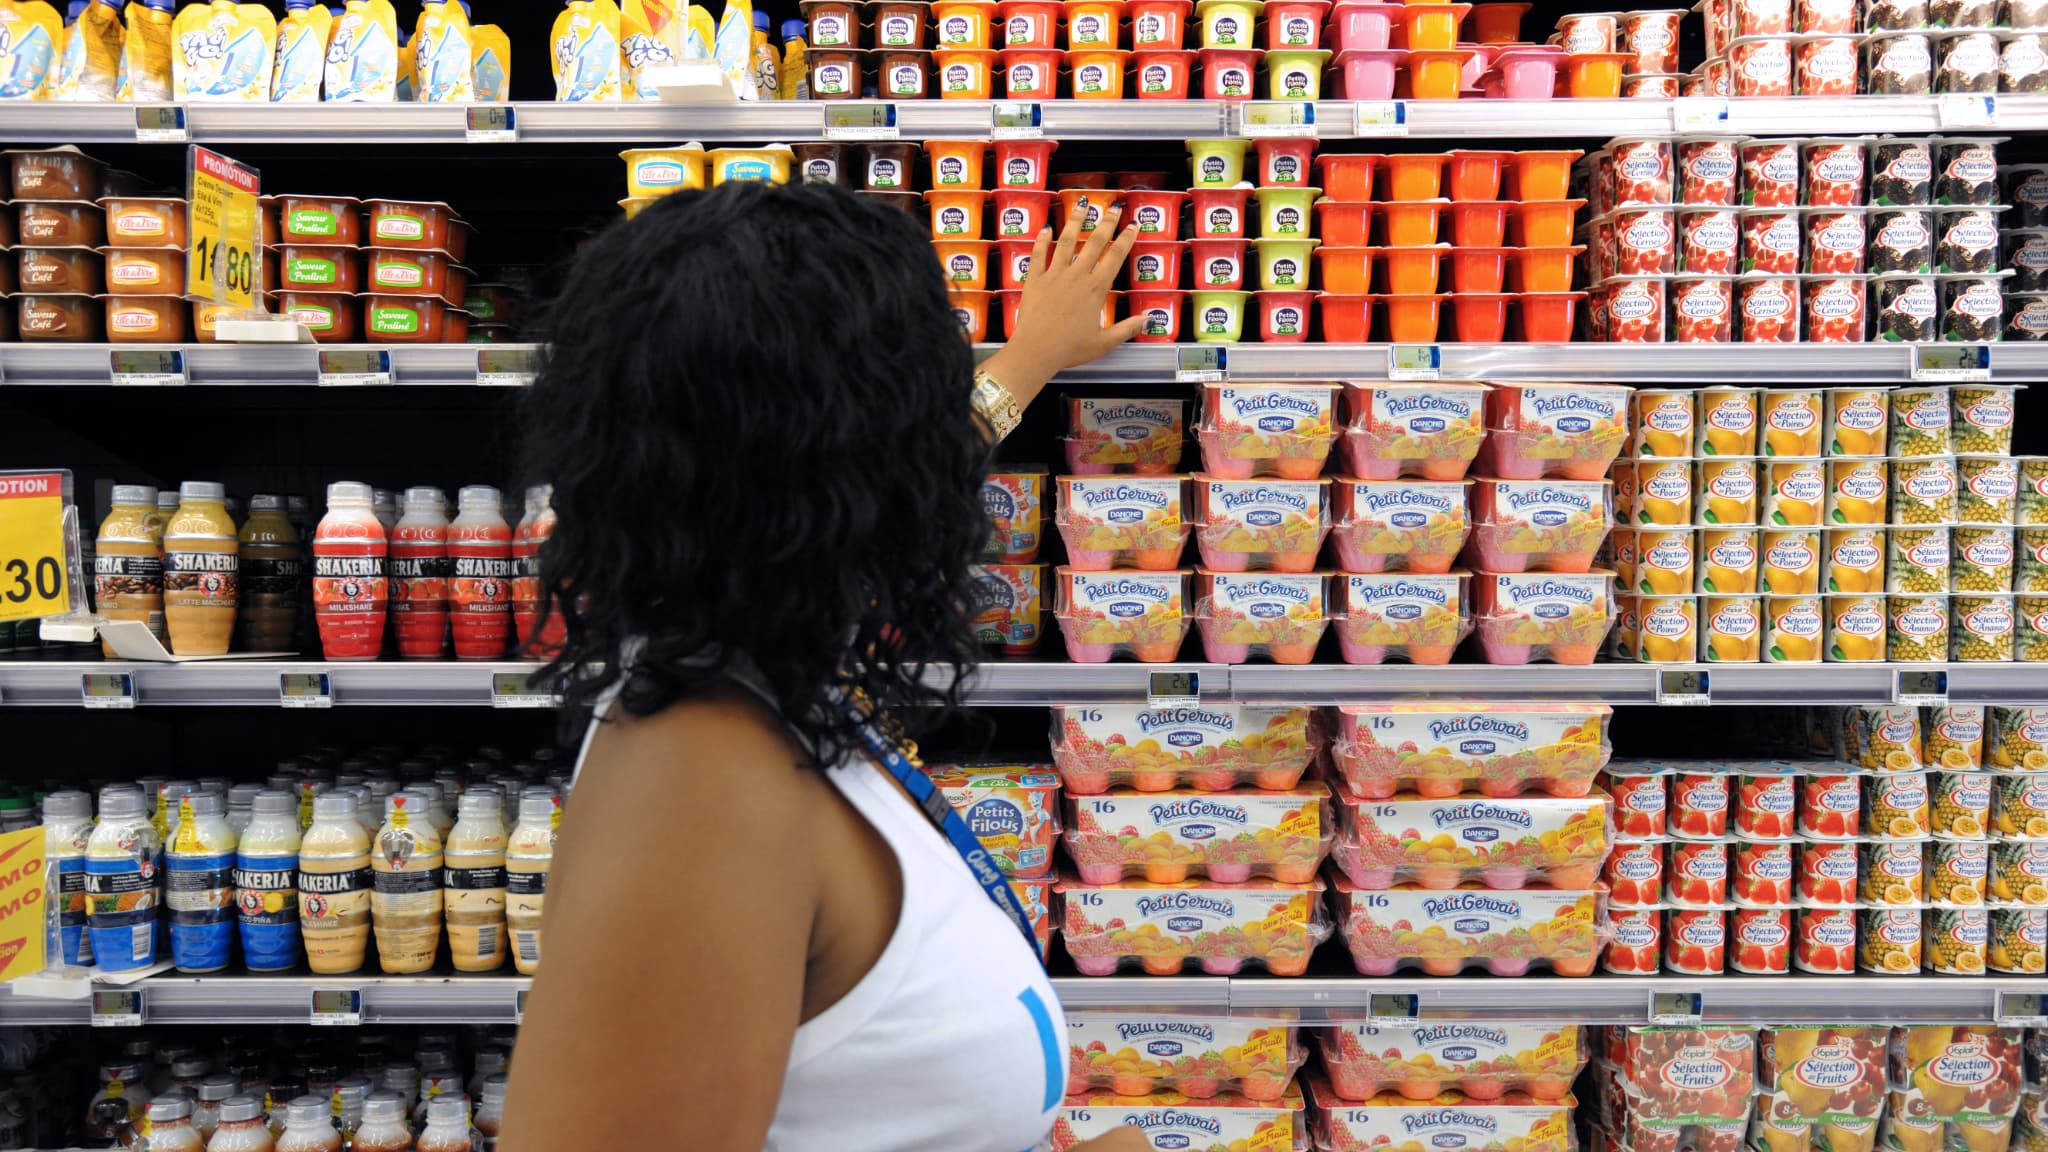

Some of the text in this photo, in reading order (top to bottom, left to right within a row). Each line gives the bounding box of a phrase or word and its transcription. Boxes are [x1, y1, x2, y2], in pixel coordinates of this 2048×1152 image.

[1697, 161, 1731, 170] Sélection
[204, 156, 252, 189] PROMOTION
[28, 216, 59, 225] Saveur
[296, 213, 327, 222] Saveur
[33, 227, 53, 236] Café
[1685, 299, 1720, 307] Sélection
[1816, 299, 1853, 307] Sélection
[27, 310, 57, 319] Saveur
[378, 310, 408, 320] Saveur
[31, 320, 52, 328] Café
[1224, 390, 1235, 399] 8
[1376, 390, 1387, 399] 8
[1236, 394, 1319, 415] Petit Gervais
[1387, 395, 1469, 416] Petit Gervais
[1775, 411, 1810, 419] Sélection
[1261, 420, 1292, 428] DANONE
[1412, 420, 1444, 428] DANONE
[1073, 483, 1084, 491] 8
[1913, 479, 1948, 487] Sélection
[1498, 484, 1510, 493] 8
[1085, 487, 1167, 507] Petit Gervais
[1510, 489, 1591, 510] Petit Gervais
[1716, 548, 1750, 557] Sélection
[317, 559, 382, 575] SHAKERIA
[1352, 578, 1363, 586] 8
[1087, 581, 1168, 600] Petit Gervais
[1363, 582, 1446, 603] Petit Gervais
[1649, 617, 1684, 625] Sélection
[1657, 625, 1678, 633] Poires
[1080, 710, 1103, 722] 16
[1140, 708, 1234, 730] Petit Gervais
[1371, 717, 1394, 729] 16
[1431, 717, 1527, 739] Petit Gervais
[1463, 743, 1494, 751] DANONE
[1692, 793, 1724, 801] Sélection
[1891, 791, 1923, 799] Sélection
[1092, 801, 1115, 813] 16
[1374, 806, 1396, 816] 16
[976, 807, 1015, 817] Petits
[1152, 801, 1246, 823] Petit Gervais
[1434, 804, 1532, 826] Petit Gervais
[972, 820, 1018, 832] Filous
[1465, 830, 1496, 838] DANONE
[1620, 860, 1654, 869] Sélection
[1080, 893, 1103, 905] 16
[1138, 894, 1234, 916] Petit Gervais
[1747, 926, 1782, 935] Sélection
[1672, 1062, 1722, 1073] Sélection
[1805, 1062, 1855, 1072] Sélection
[1940, 1059, 1990, 1069] Sélection
[1816, 1073, 1847, 1083] Fruits
[1951, 1071, 1982, 1080] Fruits
[1683, 1076, 1714, 1085] Fruits
[1651, 1107, 1656, 1115] 8
[1916, 1103, 1923, 1111] 8
[1346, 1111, 1369, 1122] 16
[1403, 1111, 1496, 1131] Petit Gervais
